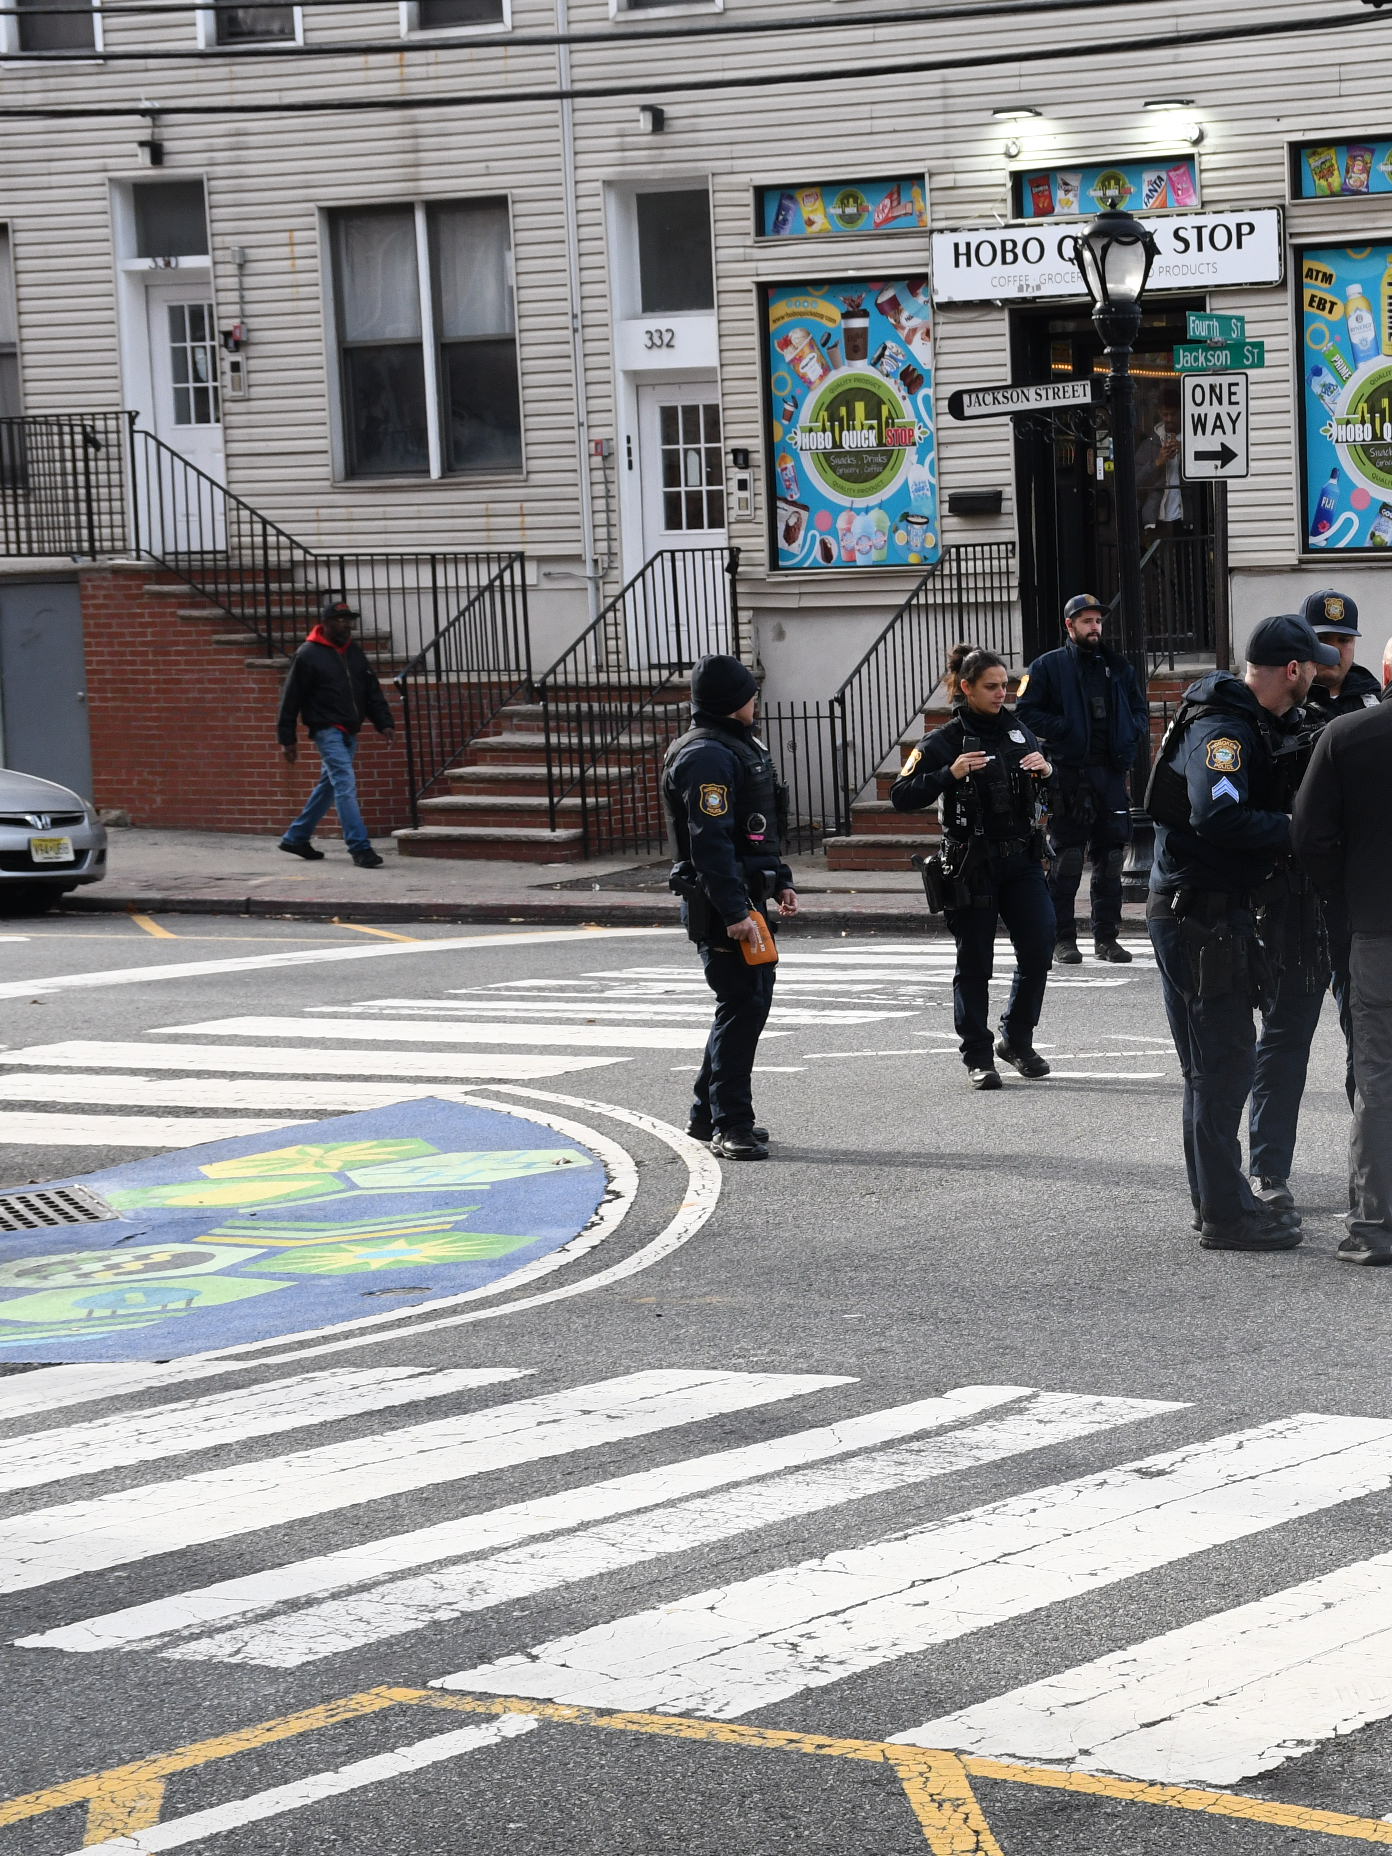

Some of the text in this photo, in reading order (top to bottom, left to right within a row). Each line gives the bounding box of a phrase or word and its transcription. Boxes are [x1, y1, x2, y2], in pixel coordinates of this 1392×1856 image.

[1143, 174, 1165, 208] FANTA
[953, 237, 1046, 269] HOBO
[1173, 221, 1256, 255] STOP
[991, 273, 1030, 288] COFFEE
[1039, 271, 1083, 285] GROCER
[1158, 262, 1218, 277] PRODUCTS
[1304, 267, 1334, 285] ATM
[1307, 293, 1338, 315] EBT
[644, 328, 675, 350] 332
[1175, 347, 1231, 369] Jackson
[966, 382, 1090, 408] JACKSON STREET
[1191, 381, 1241, 407] ONE
[1190, 411, 1242, 436] WAY
[1337, 423, 1373, 442] HOBO
[801, 427, 915, 450] HOBO QUICK STOP
[864, 454, 888, 464] Drinks
[1321, 496, 1335, 510] FIJI
